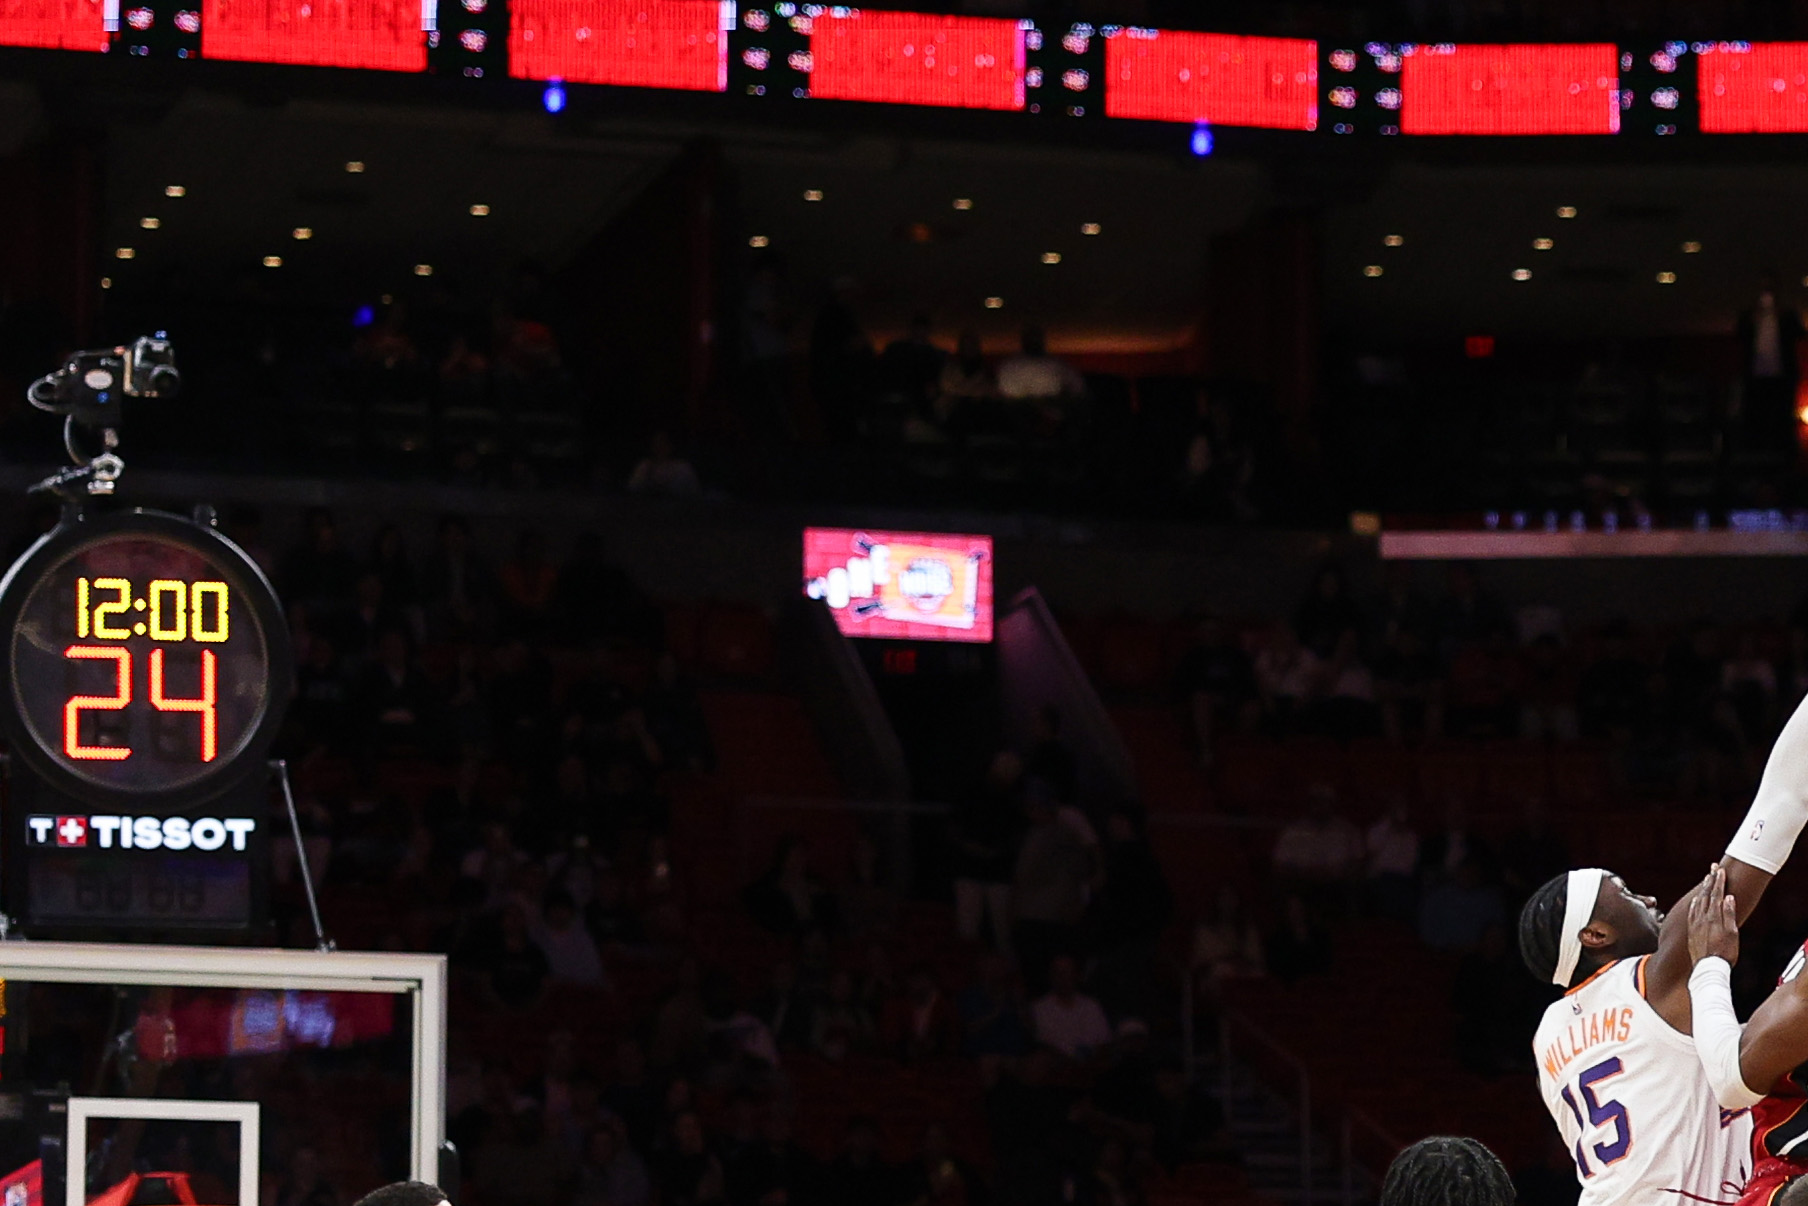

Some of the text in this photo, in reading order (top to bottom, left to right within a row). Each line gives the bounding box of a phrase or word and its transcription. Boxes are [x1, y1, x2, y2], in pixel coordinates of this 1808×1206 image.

[77, 577, 229, 642] 12:00
[63, 645, 218, 762] 24
[89, 816, 255, 851] TISSOT
[1543, 1007, 1633, 1081] WILLIAMS
[1561, 1056, 1634, 1179] 15
